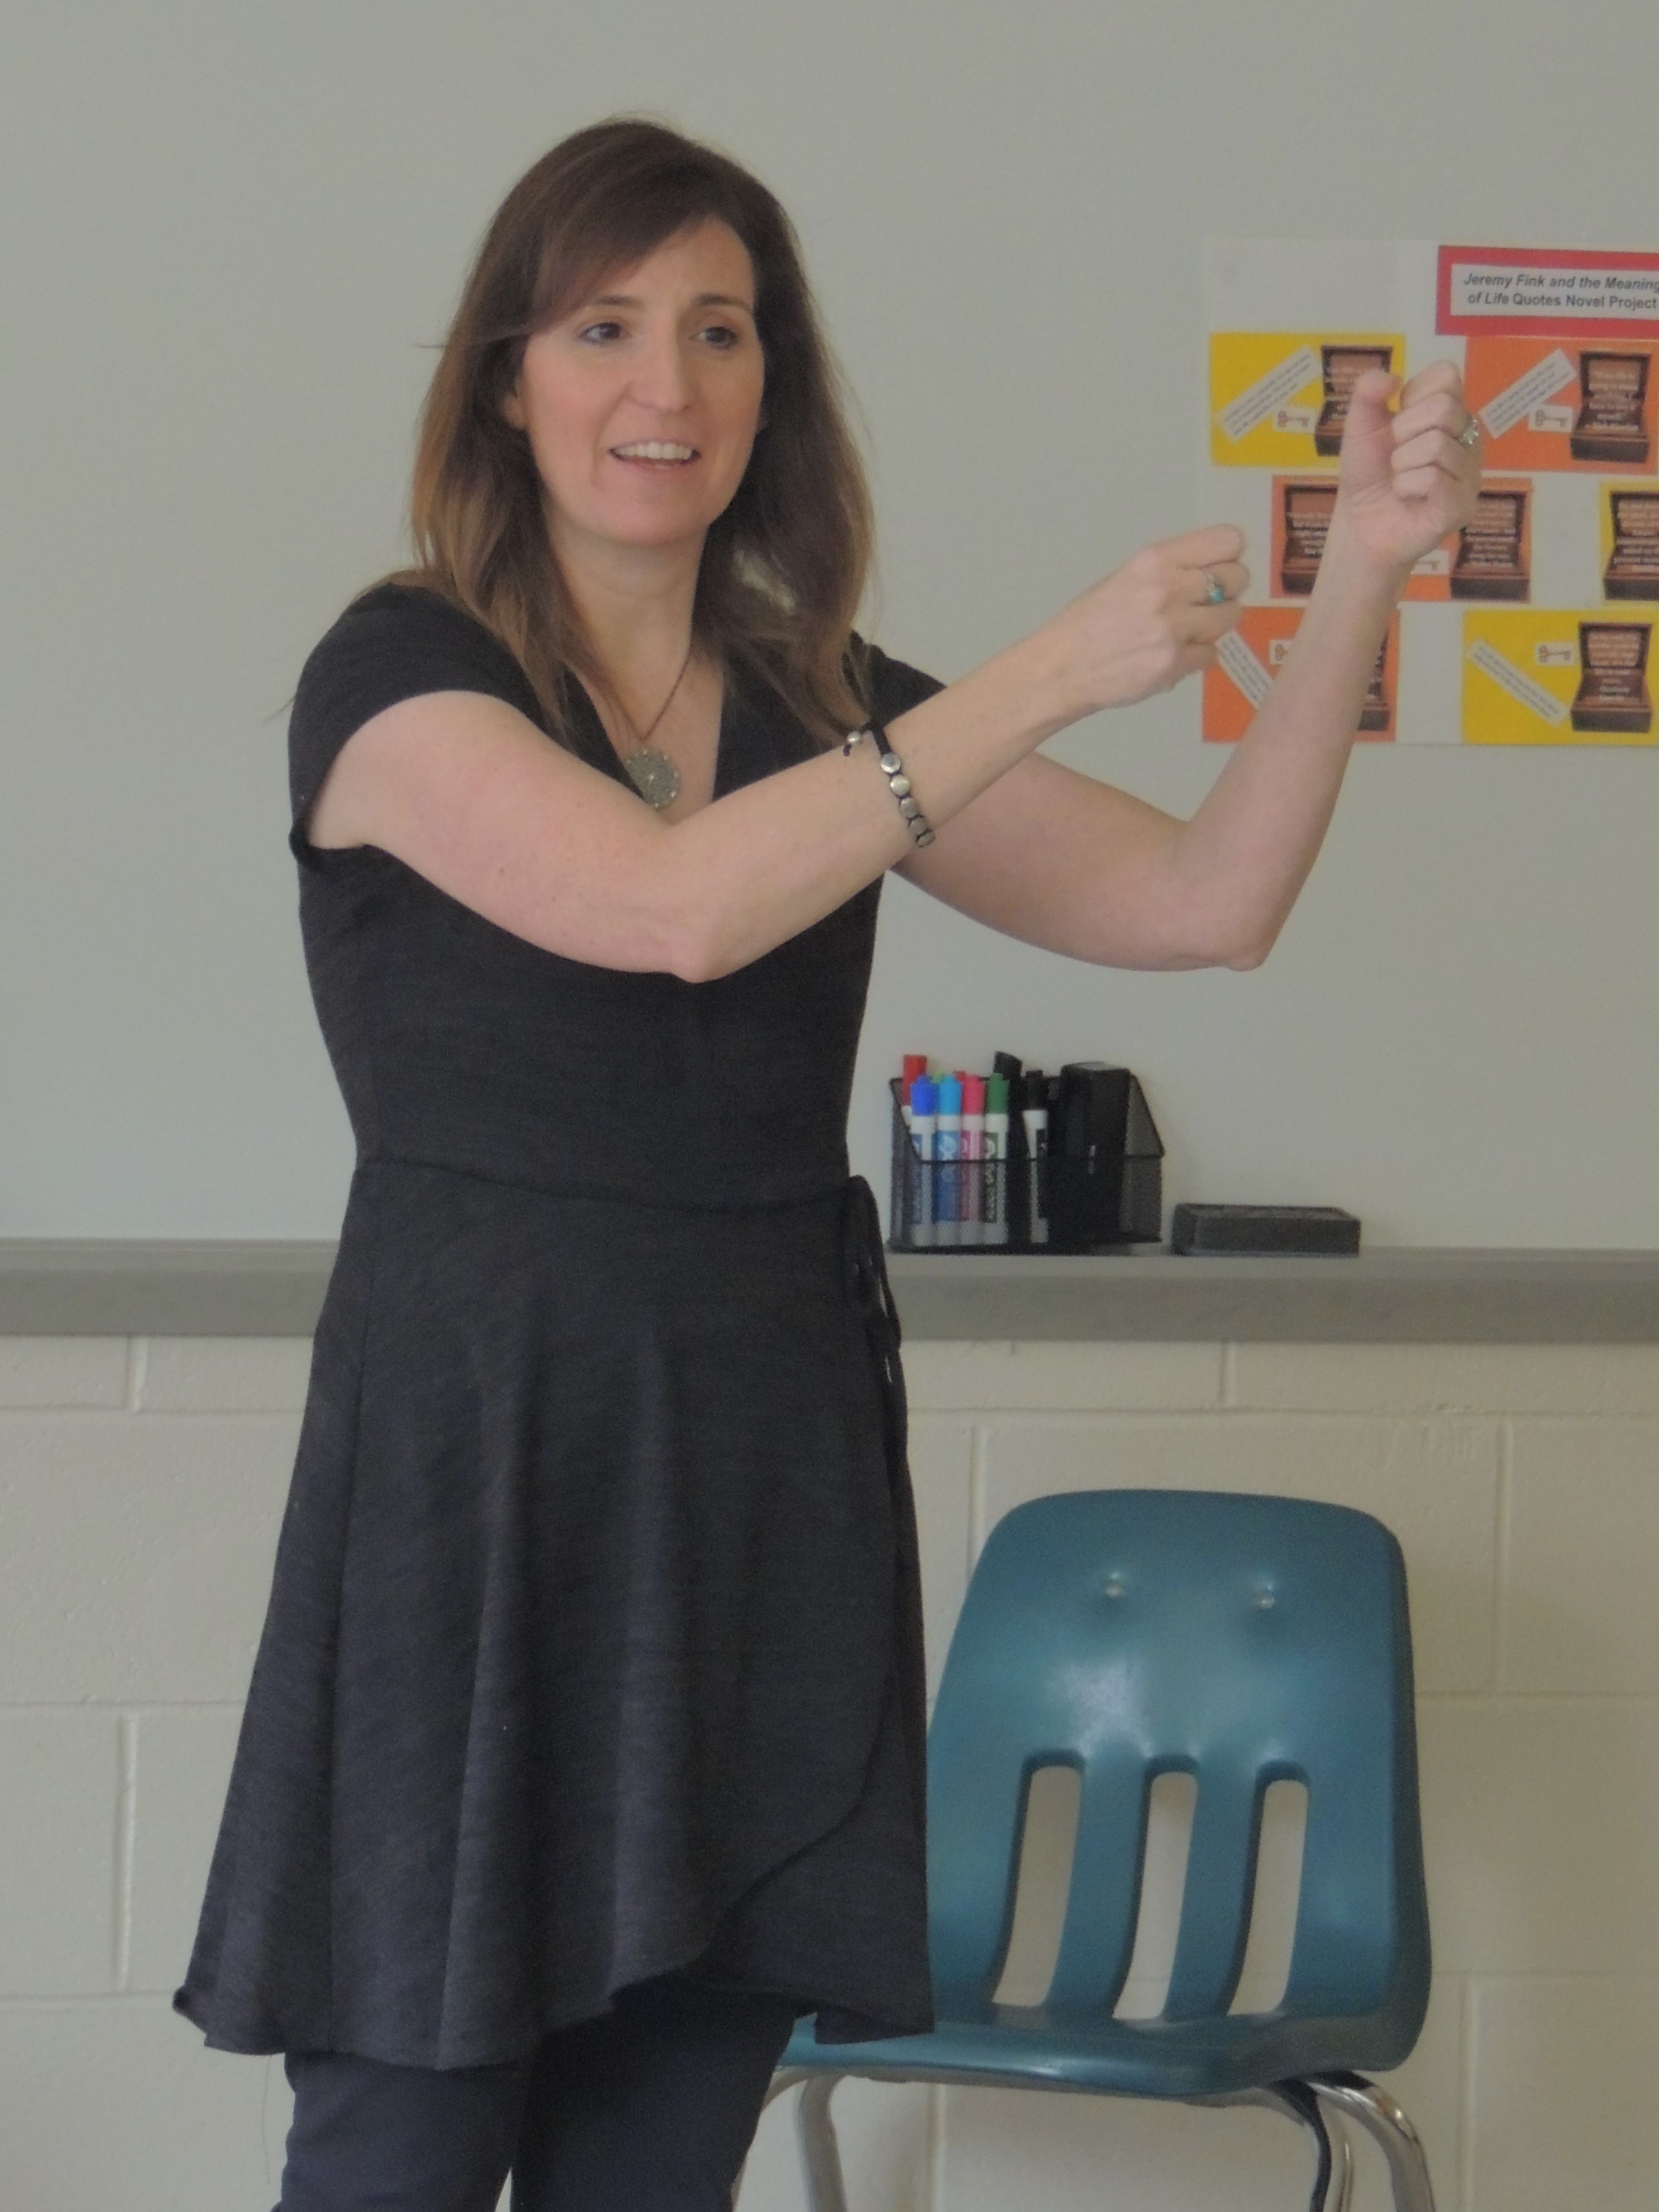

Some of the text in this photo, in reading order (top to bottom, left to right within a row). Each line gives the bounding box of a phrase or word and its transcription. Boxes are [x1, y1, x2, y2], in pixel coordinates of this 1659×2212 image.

[1464, 274, 1512, 288] Jeremy
[1516, 274, 1544, 287] Fink
[1549, 276, 1575, 288] and
[1579, 276, 1601, 288] the
[1468, 293, 1657, 311] of Life Quotes Novel Project
